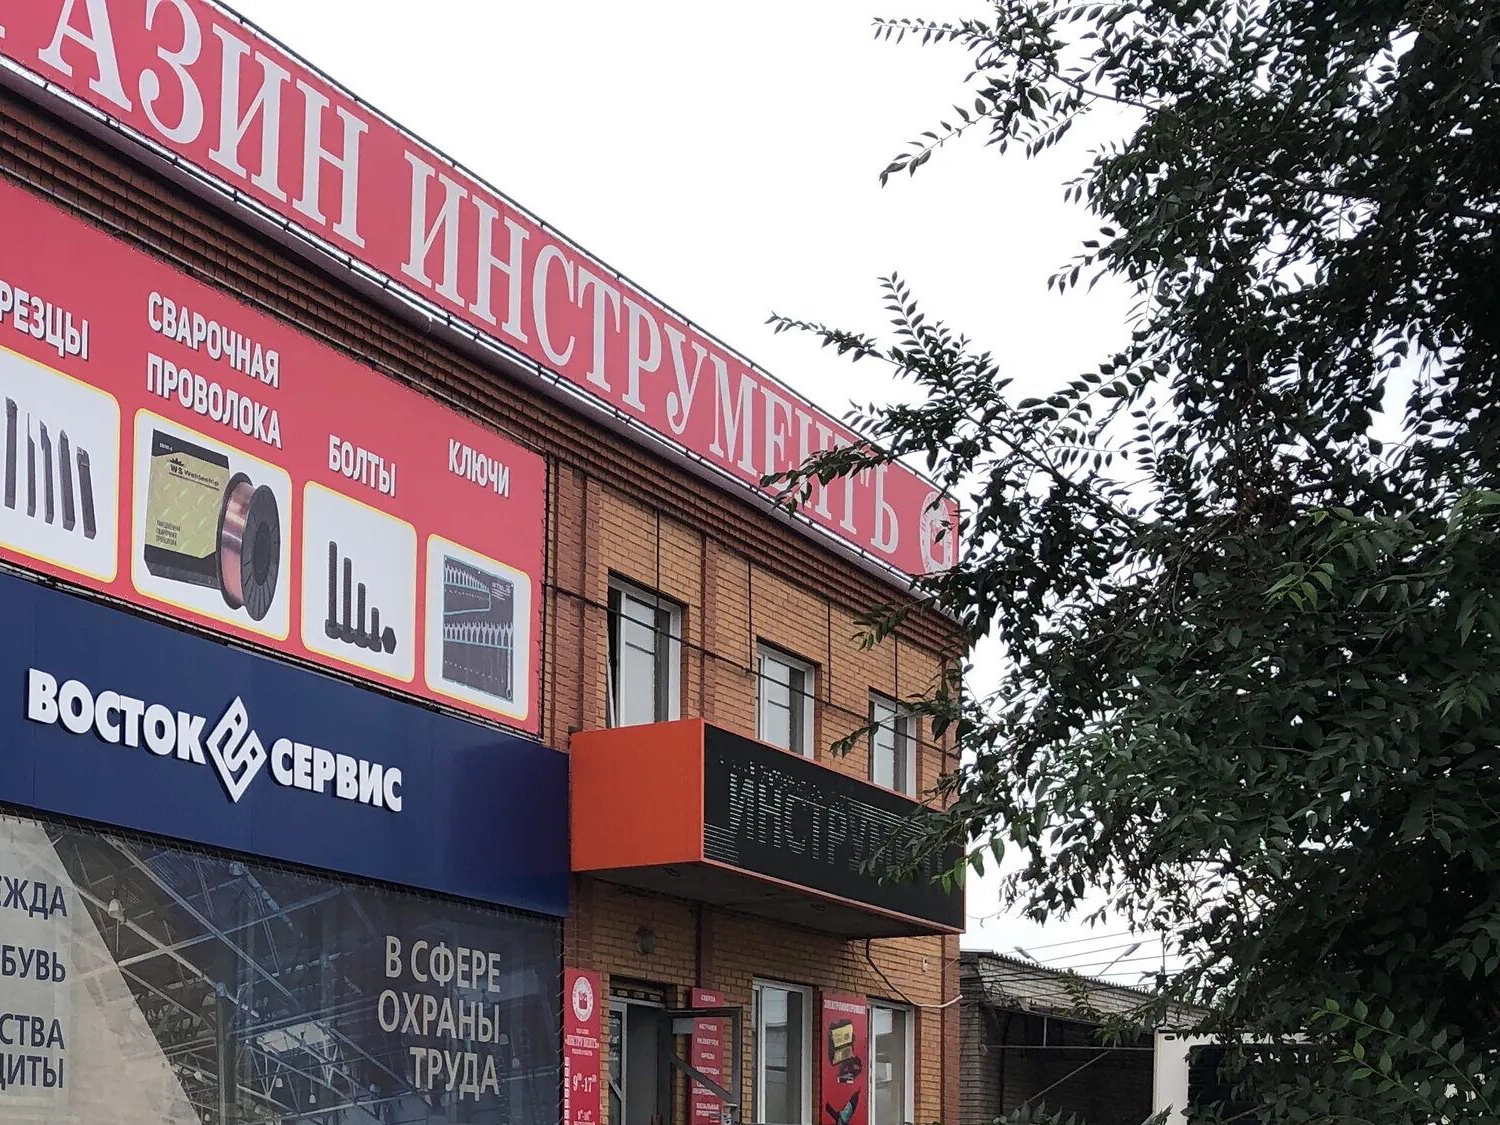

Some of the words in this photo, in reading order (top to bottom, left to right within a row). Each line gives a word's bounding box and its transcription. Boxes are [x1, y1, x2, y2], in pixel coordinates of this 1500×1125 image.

[148, 291, 280, 388] СВАРОЧНАЯ
[147, 352, 283, 449] ПРОВОЛОКА
[328, 434, 396, 497] БОЛТЫ
[448, 438, 510, 498] КЛЮЧИ
[28, 668, 206, 765] ВОСТОК
[270, 737, 402, 812] СЕРВИС
[385, 935, 401, 979] В
[410, 940, 501, 994] СФЕРЕ
[377, 989, 500, 1045] ОХРАНЫ
[410, 1045, 500, 1101] ТРУДА
